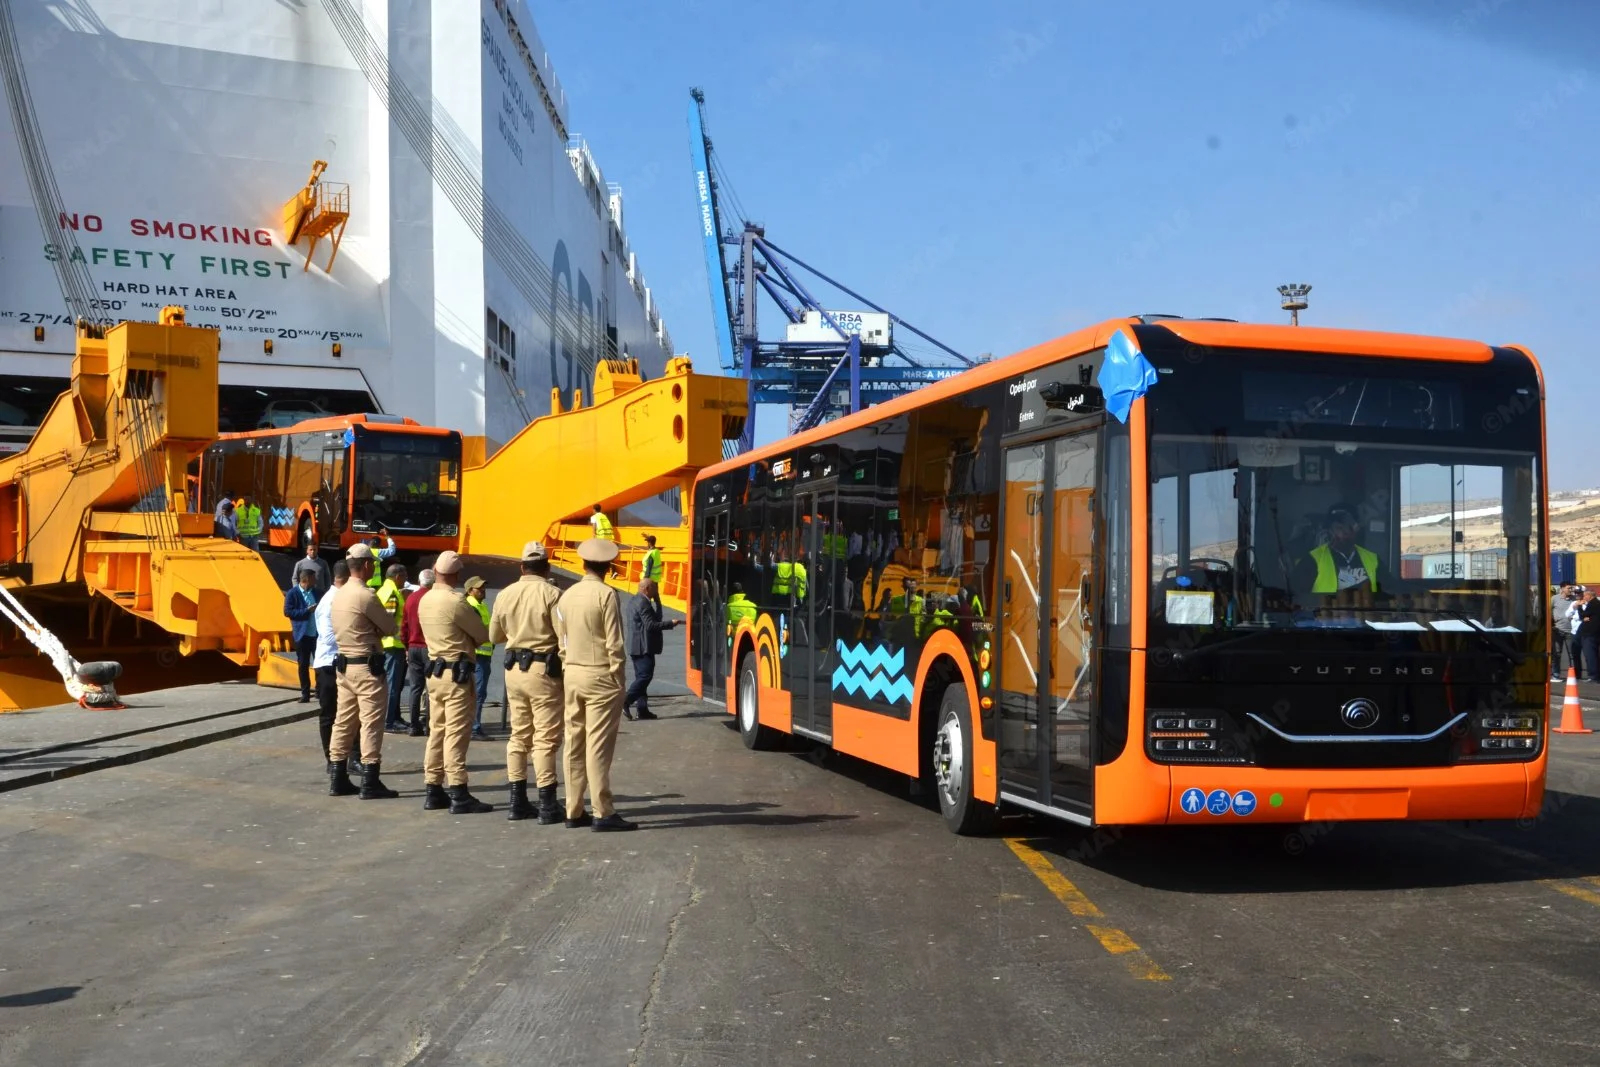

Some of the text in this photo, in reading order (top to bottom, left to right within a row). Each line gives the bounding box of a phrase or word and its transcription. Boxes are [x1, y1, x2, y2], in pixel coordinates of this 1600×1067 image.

[482, 17, 507, 84] GRANDE
[59, 211, 273, 247] NO SMOKING
[702, 204, 713, 237] MAROC
[44, 243, 291, 279] SAFETY FIRST
[104, 282, 237, 300] HARD HAT AREA
[248, 326, 275, 334] SPEED
[820, 320, 862, 331] MROC
[1289, 666, 1434, 676] YUTONG
